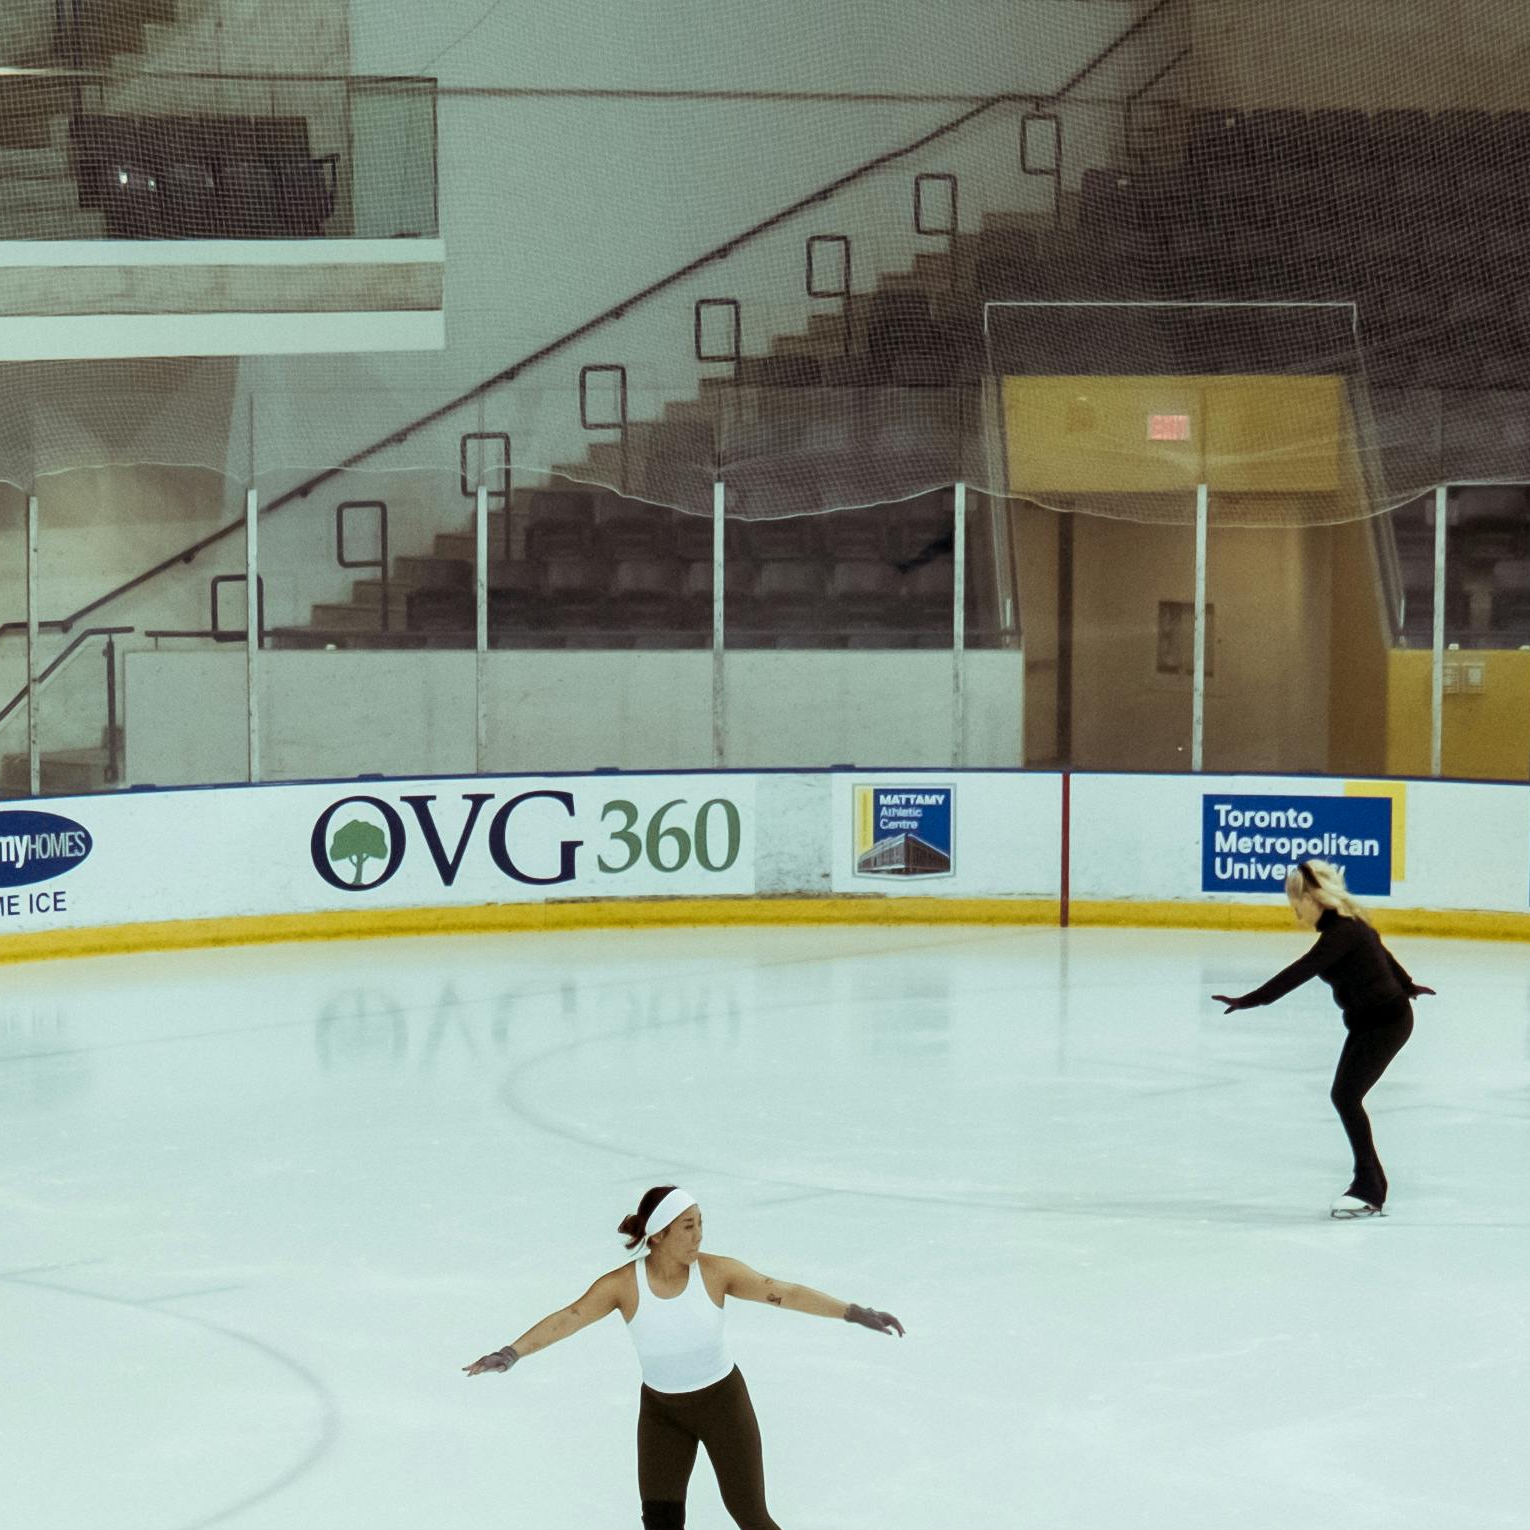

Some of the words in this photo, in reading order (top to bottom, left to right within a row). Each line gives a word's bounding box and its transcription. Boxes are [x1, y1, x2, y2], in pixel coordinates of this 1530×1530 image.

[879, 794, 945, 806] MATTAMY
[880, 806, 923, 817] Athletic
[1214, 804, 1314, 828] Toronto
[879, 818, 918, 830] Centre
[1214, 831, 1379, 860] Metropolitan
[29, 891, 67, 914] ICE
